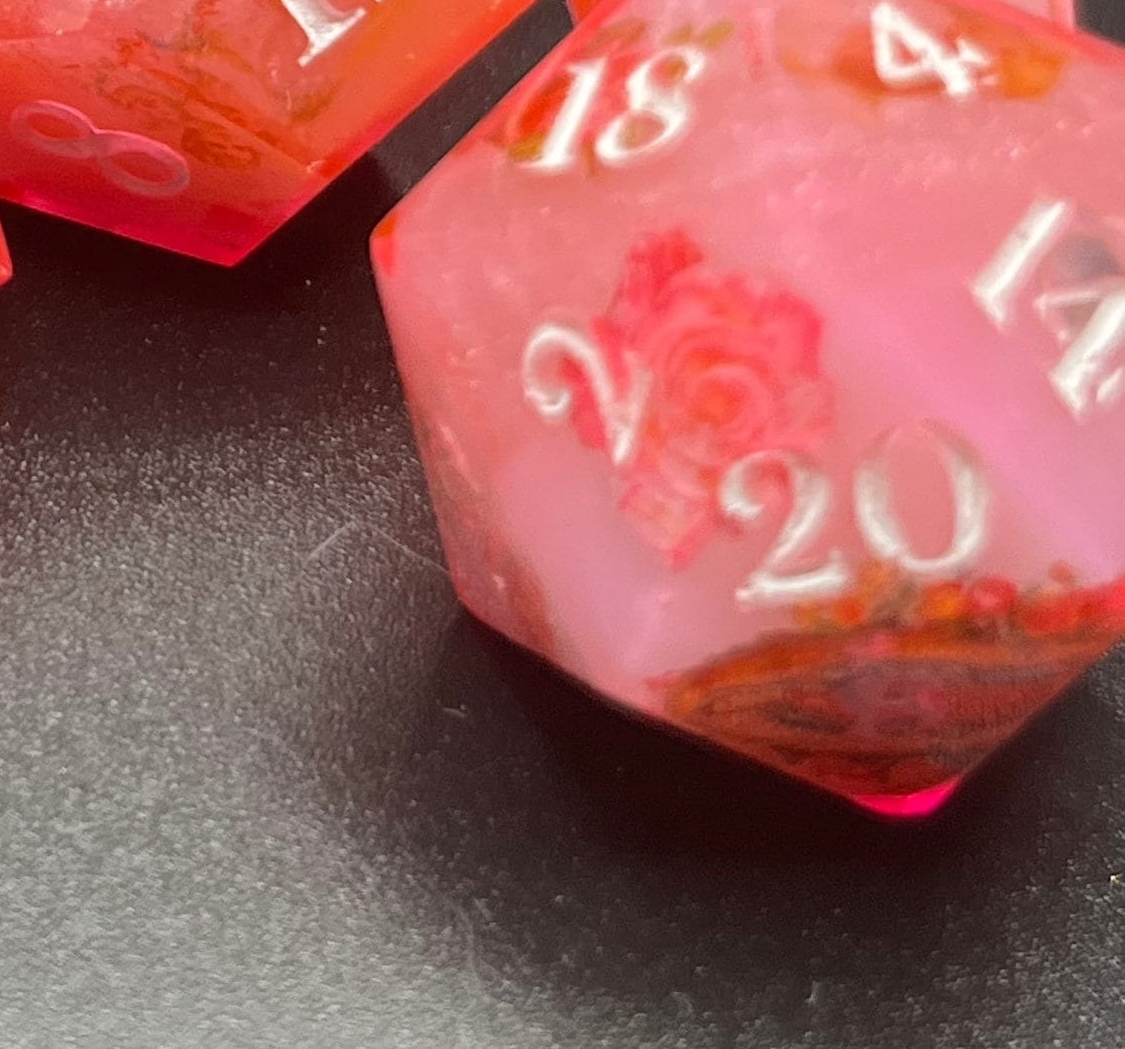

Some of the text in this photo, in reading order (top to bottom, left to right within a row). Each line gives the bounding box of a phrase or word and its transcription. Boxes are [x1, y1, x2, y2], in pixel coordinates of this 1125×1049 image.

[871, 1, 1001, 102] 4
[9, 98, 192, 198] 8
[514, 47, 707, 174] 18
[717, 419, 989, 604] 20
